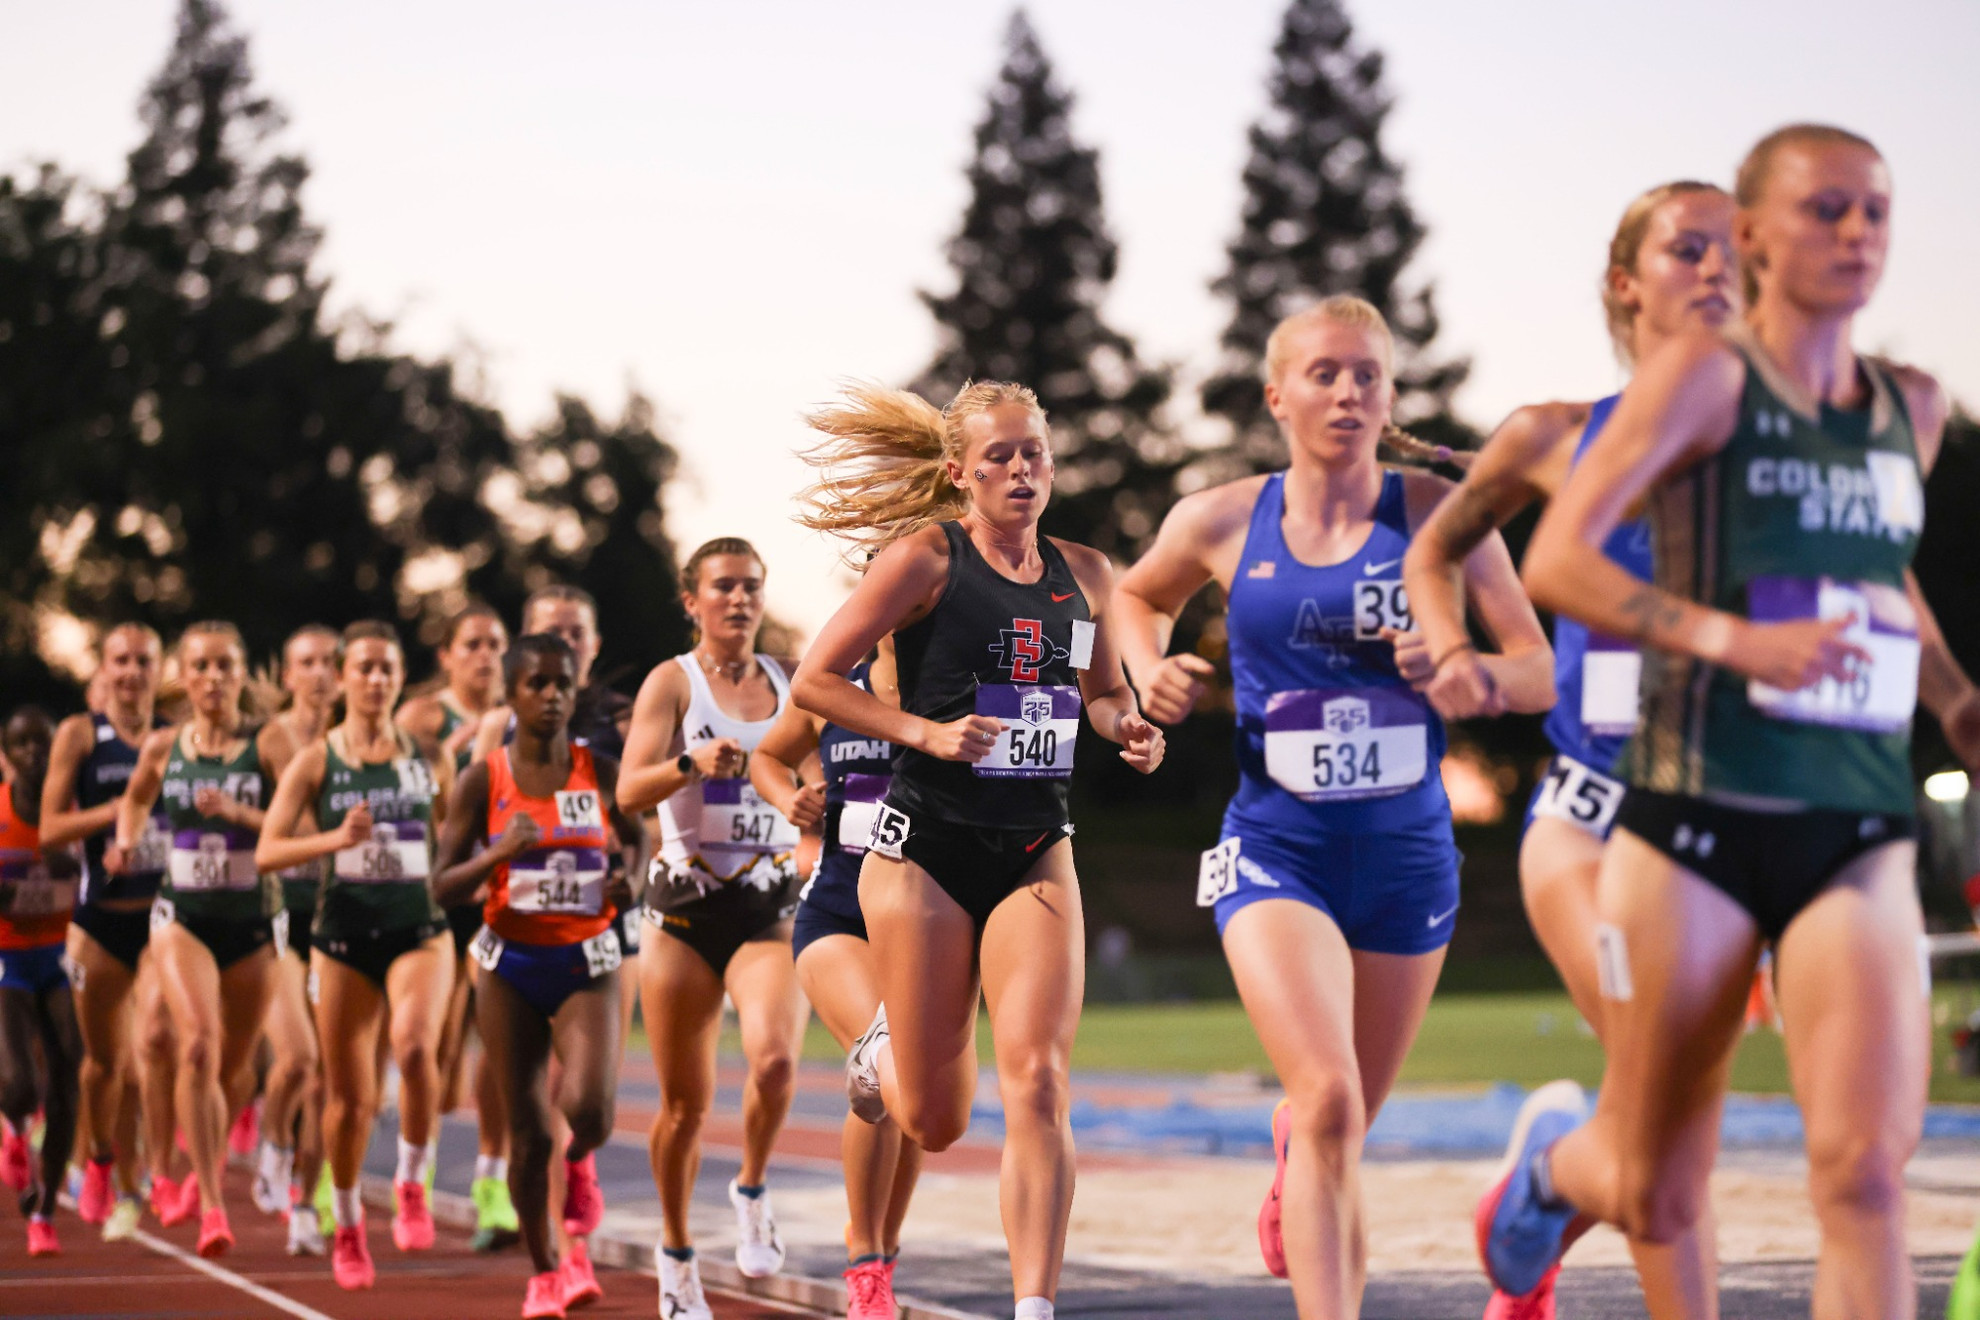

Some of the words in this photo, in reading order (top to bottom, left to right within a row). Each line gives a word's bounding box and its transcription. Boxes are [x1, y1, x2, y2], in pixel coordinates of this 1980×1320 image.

[1361, 584, 1414, 636] 39
[1024, 701, 1051, 717] 25
[1328, 707, 1368, 729] 25
[830, 740, 890, 763] UTAH
[1010, 729, 1056, 767] 540
[1313, 741, 1382, 788] 534
[563, 794, 594, 822] 49
[731, 814, 775, 843] 547
[871, 807, 906, 847] 45
[537, 879, 581, 906] 544
